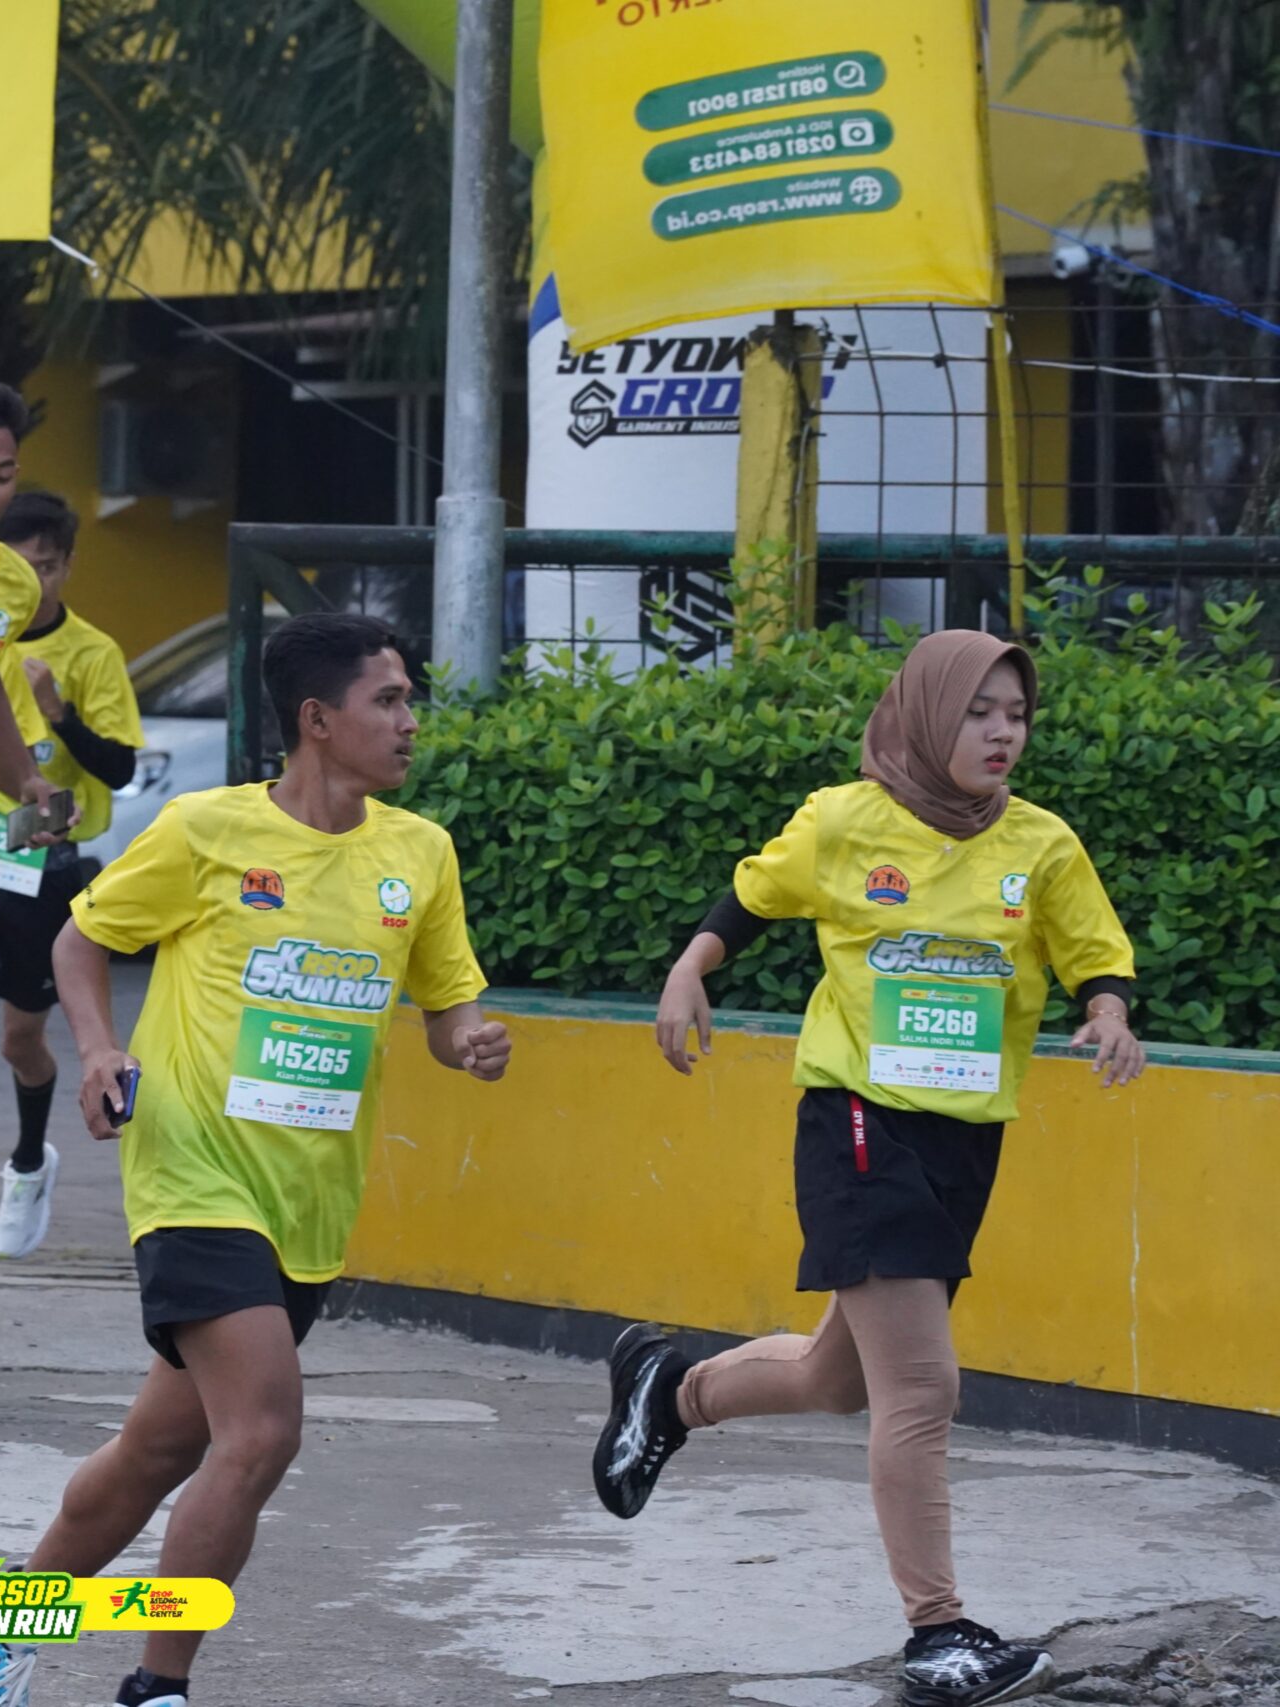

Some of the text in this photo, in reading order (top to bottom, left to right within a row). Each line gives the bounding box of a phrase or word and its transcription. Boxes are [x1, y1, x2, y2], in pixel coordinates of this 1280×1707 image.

[616, 420, 740, 434] GARMENT INDUS
[381, 917, 408, 928] RSOP
[300, 952, 375, 980] RSOP
[272, 973, 391, 1009] FUN RUN
[898, 1005, 978, 1036] F5268
[260, 1037, 352, 1075] M5265
[853, 1111, 865, 1146] TNI AD
